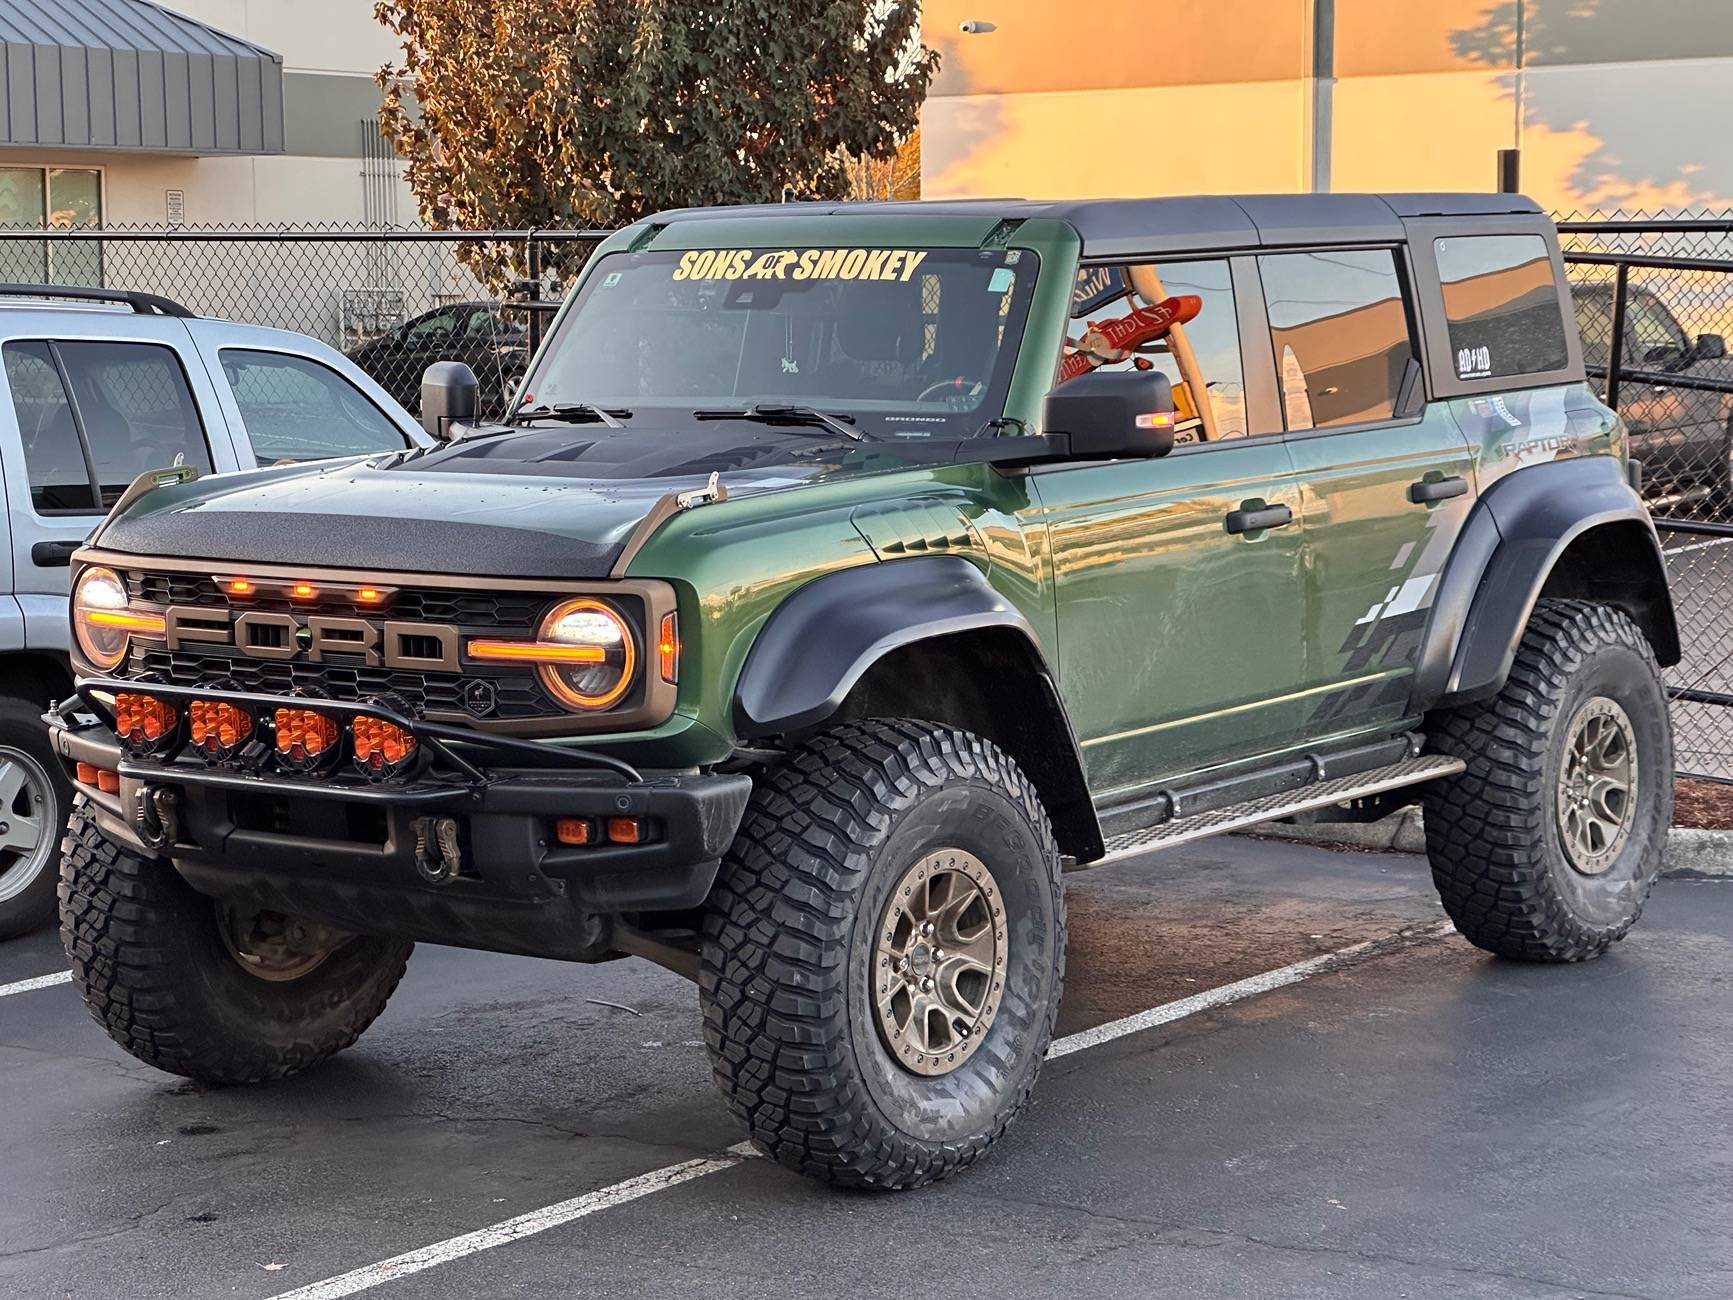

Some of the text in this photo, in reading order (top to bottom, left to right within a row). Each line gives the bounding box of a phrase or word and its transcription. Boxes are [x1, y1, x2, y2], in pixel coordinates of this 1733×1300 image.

[672, 249, 928, 282] SONS OF SMOKEY
[1503, 436, 1578, 458] RAPTOR
[166, 606, 462, 673] FORD
